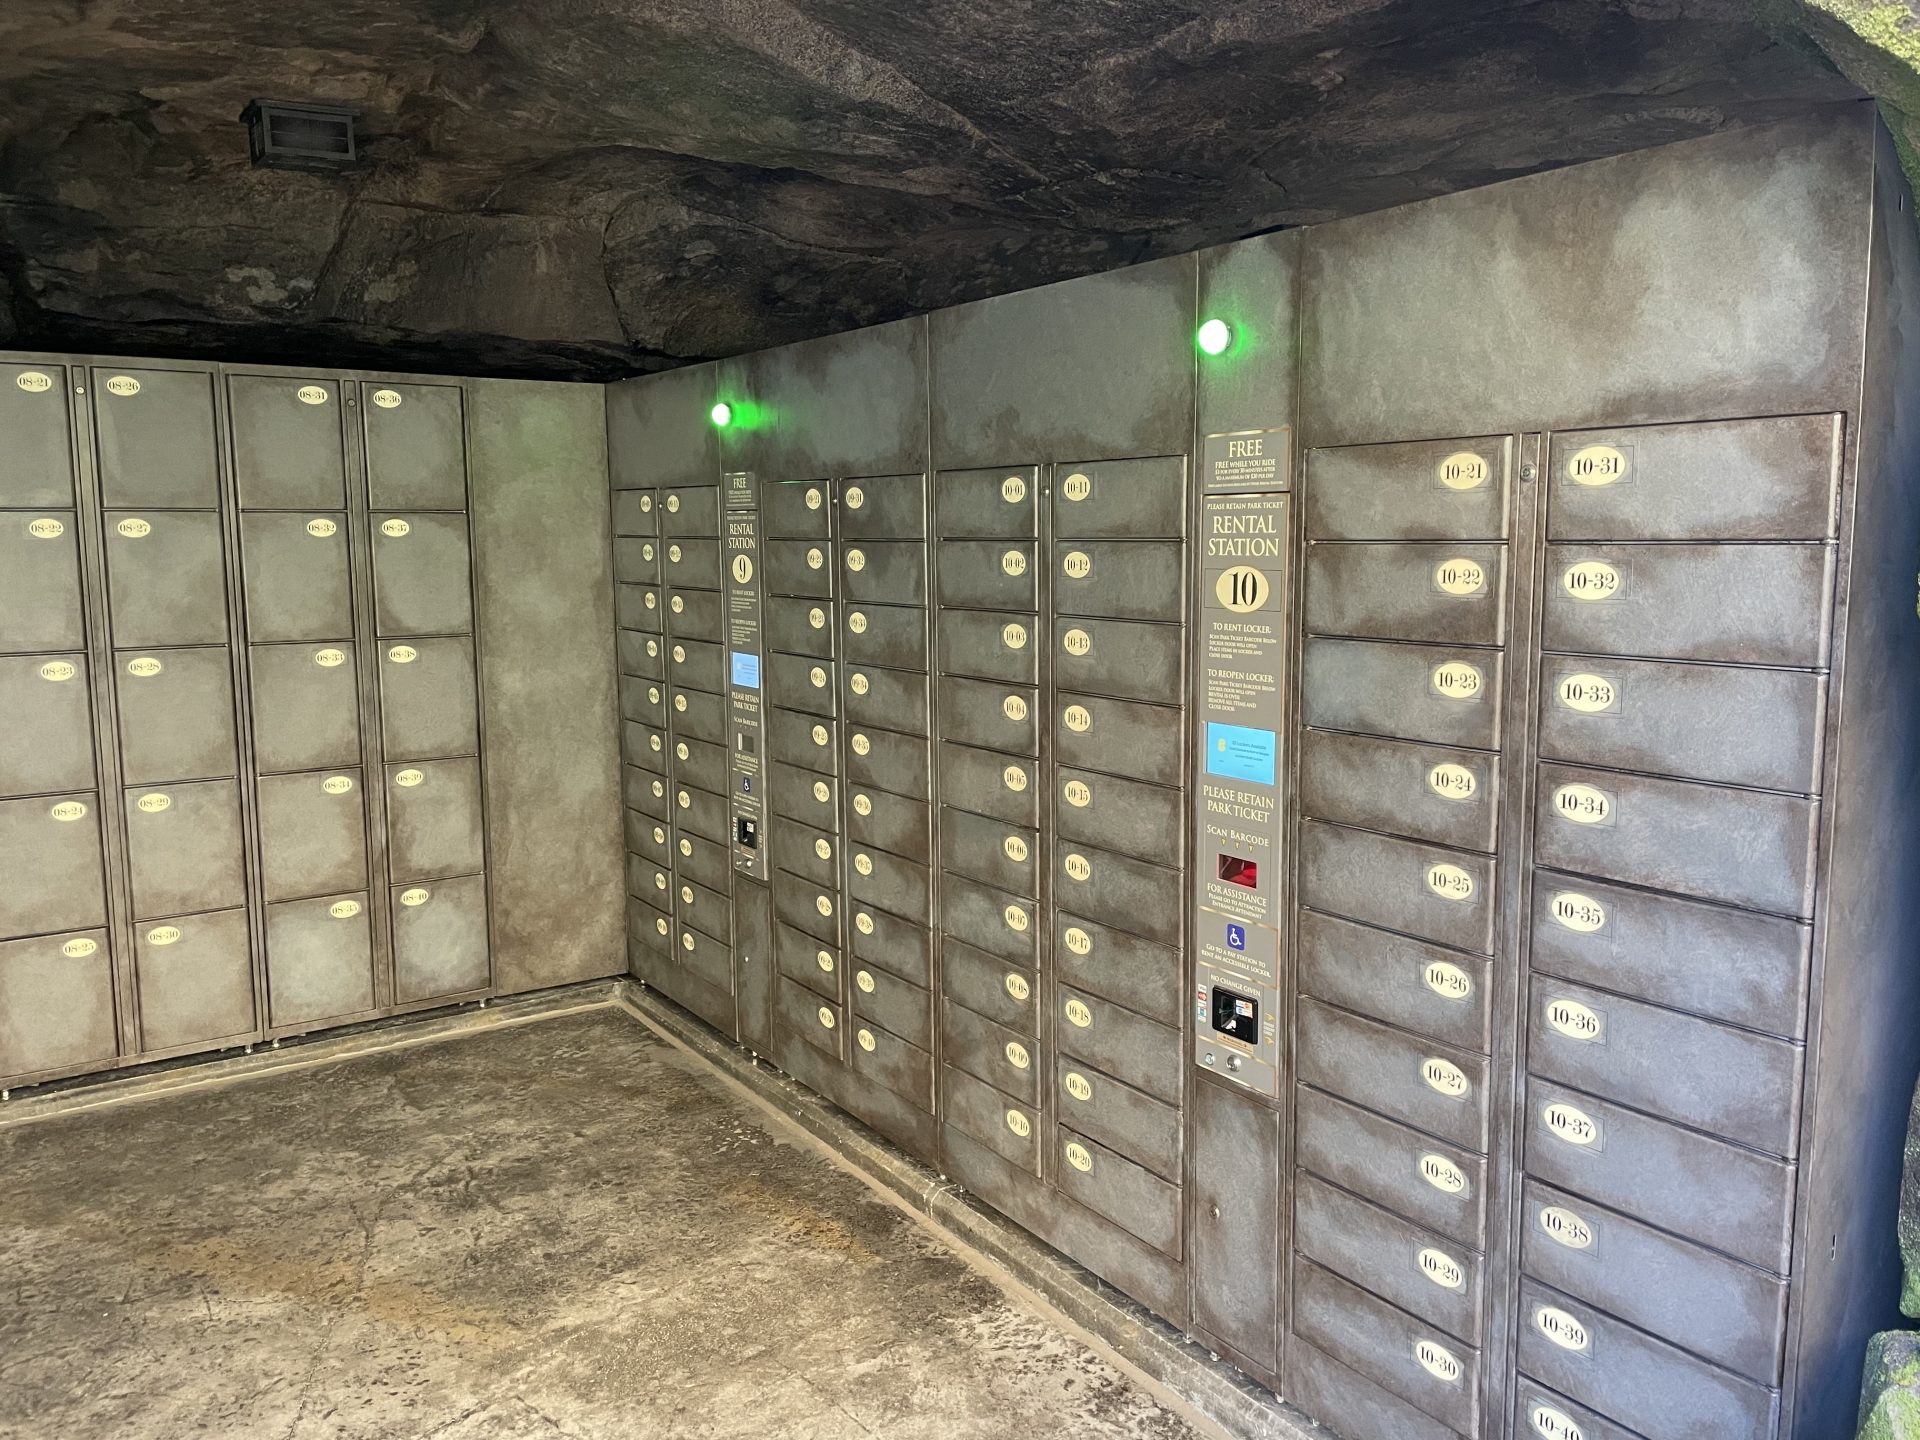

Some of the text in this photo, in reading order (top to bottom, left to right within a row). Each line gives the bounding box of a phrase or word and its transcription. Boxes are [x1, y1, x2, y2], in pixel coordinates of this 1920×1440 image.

[19, 377, 48, 387] 08-21
[108, 381, 138, 390] 08-26
[300, 391, 324, 400] 08-31
[375, 395, 400, 403] 08-36
[1229, 439, 1263, 458] FREE
[1215, 458, 1276, 469] FREE WHILE YOU RIDE
[1444, 463, 1482, 480] 10-21
[1574, 457, 1620, 475] 10-31
[733, 478, 746, 488] FREE
[1005, 484, 1022, 496] 10-01
[1068, 481, 1087, 494] 10-11
[31, 524, 61, 533] 08-22
[119, 524, 147, 532] 08-27
[308, 524, 334, 532] 08-32
[383, 524, 406, 532] 08-37
[729, 523, 754, 535] RENTAL
[1212, 515, 1277, 534] RENTAL
[728, 538, 755, 549] STATION
[1208, 538, 1280, 556] STATION
[739, 557, 746, 580] 9
[1005, 558, 1024, 569] 10-02
[1067, 559, 1088, 571] 10-12
[1440, 568, 1480, 584] 10-22
[1568, 572, 1615, 590] 10-32
[1228, 572, 1257, 606] 10
[1213, 622, 1223, 630] TO
[1223, 623, 1242, 632] RENT
[1006, 630, 1025, 642] 10-03
[1068, 636, 1088, 648] 10-13
[317, 654, 343, 662] 08-33
[390, 650, 415, 658] 08-38
[42, 667, 73, 676] 08-23
[130, 663, 160, 671] 08-28
[1208, 668, 1217, 677] TO
[1218, 669, 1244, 680] REOPEN
[1438, 672, 1477, 689] 10-23
[1565, 683, 1610, 703] 10-33
[1068, 712, 1088, 726] 10-14
[397, 774, 422, 782] 08-39
[1007, 772, 1025, 786] 10-05
[1434, 771, 1472, 792] 10-24
[1068, 787, 1088, 801] 10-15
[1203, 785, 1274, 809] PLEASE RETAIN
[140, 798, 169, 807] 08-29
[1559, 793, 1606, 815] 10-34
[1207, 800, 1270, 823] PARK TICKET
[1206, 824, 1270, 847] SCAN BARCODE
[1008, 842, 1026, 856] 10-06
[1068, 860, 1088, 875] 10-16
[1431, 871, 1470, 894] 10-25
[1207, 882, 1267, 907] FOR ASSISTANCE
[332, 904, 358, 913] 08-35
[1556, 901, 1602, 925] 10-35
[1008, 910, 1025, 926] 10-07
[150, 931, 178, 941] 08-30
[1068, 933, 1088, 949] 10-17
[64, 942, 94, 953] 08-25
[1201, 950, 1214, 958] RENT
[1223, 956, 1250, 970] ACCESSIBLE
[1227, 951, 1236, 959] PAY
[1236, 954, 1258, 965] STATION
[1211, 974, 1261, 997] NO CHANGE GIVEN
[1428, 968, 1467, 993] 10-26
[1069, 1005, 1089, 1022] 10-18
[1551, 1007, 1596, 1034] 10-36
[1009, 1046, 1028, 1064] 10-09
[1426, 1065, 1463, 1090] 10-27
[1069, 1078, 1089, 1096] 10-19
[1010, 1114, 1028, 1132] 10-10
[1549, 1110, 1593, 1138] 10-37
[1069, 1147, 1090, 1167] 10-20
[1424, 1161, 1462, 1188] 10-28
[1544, 1213, 1588, 1242] 10-38
[1422, 1254, 1460, 1283] 10-29
[1542, 1313, 1584, 1345] 10-39
[1419, 1346, 1456, 1376] 10-30
